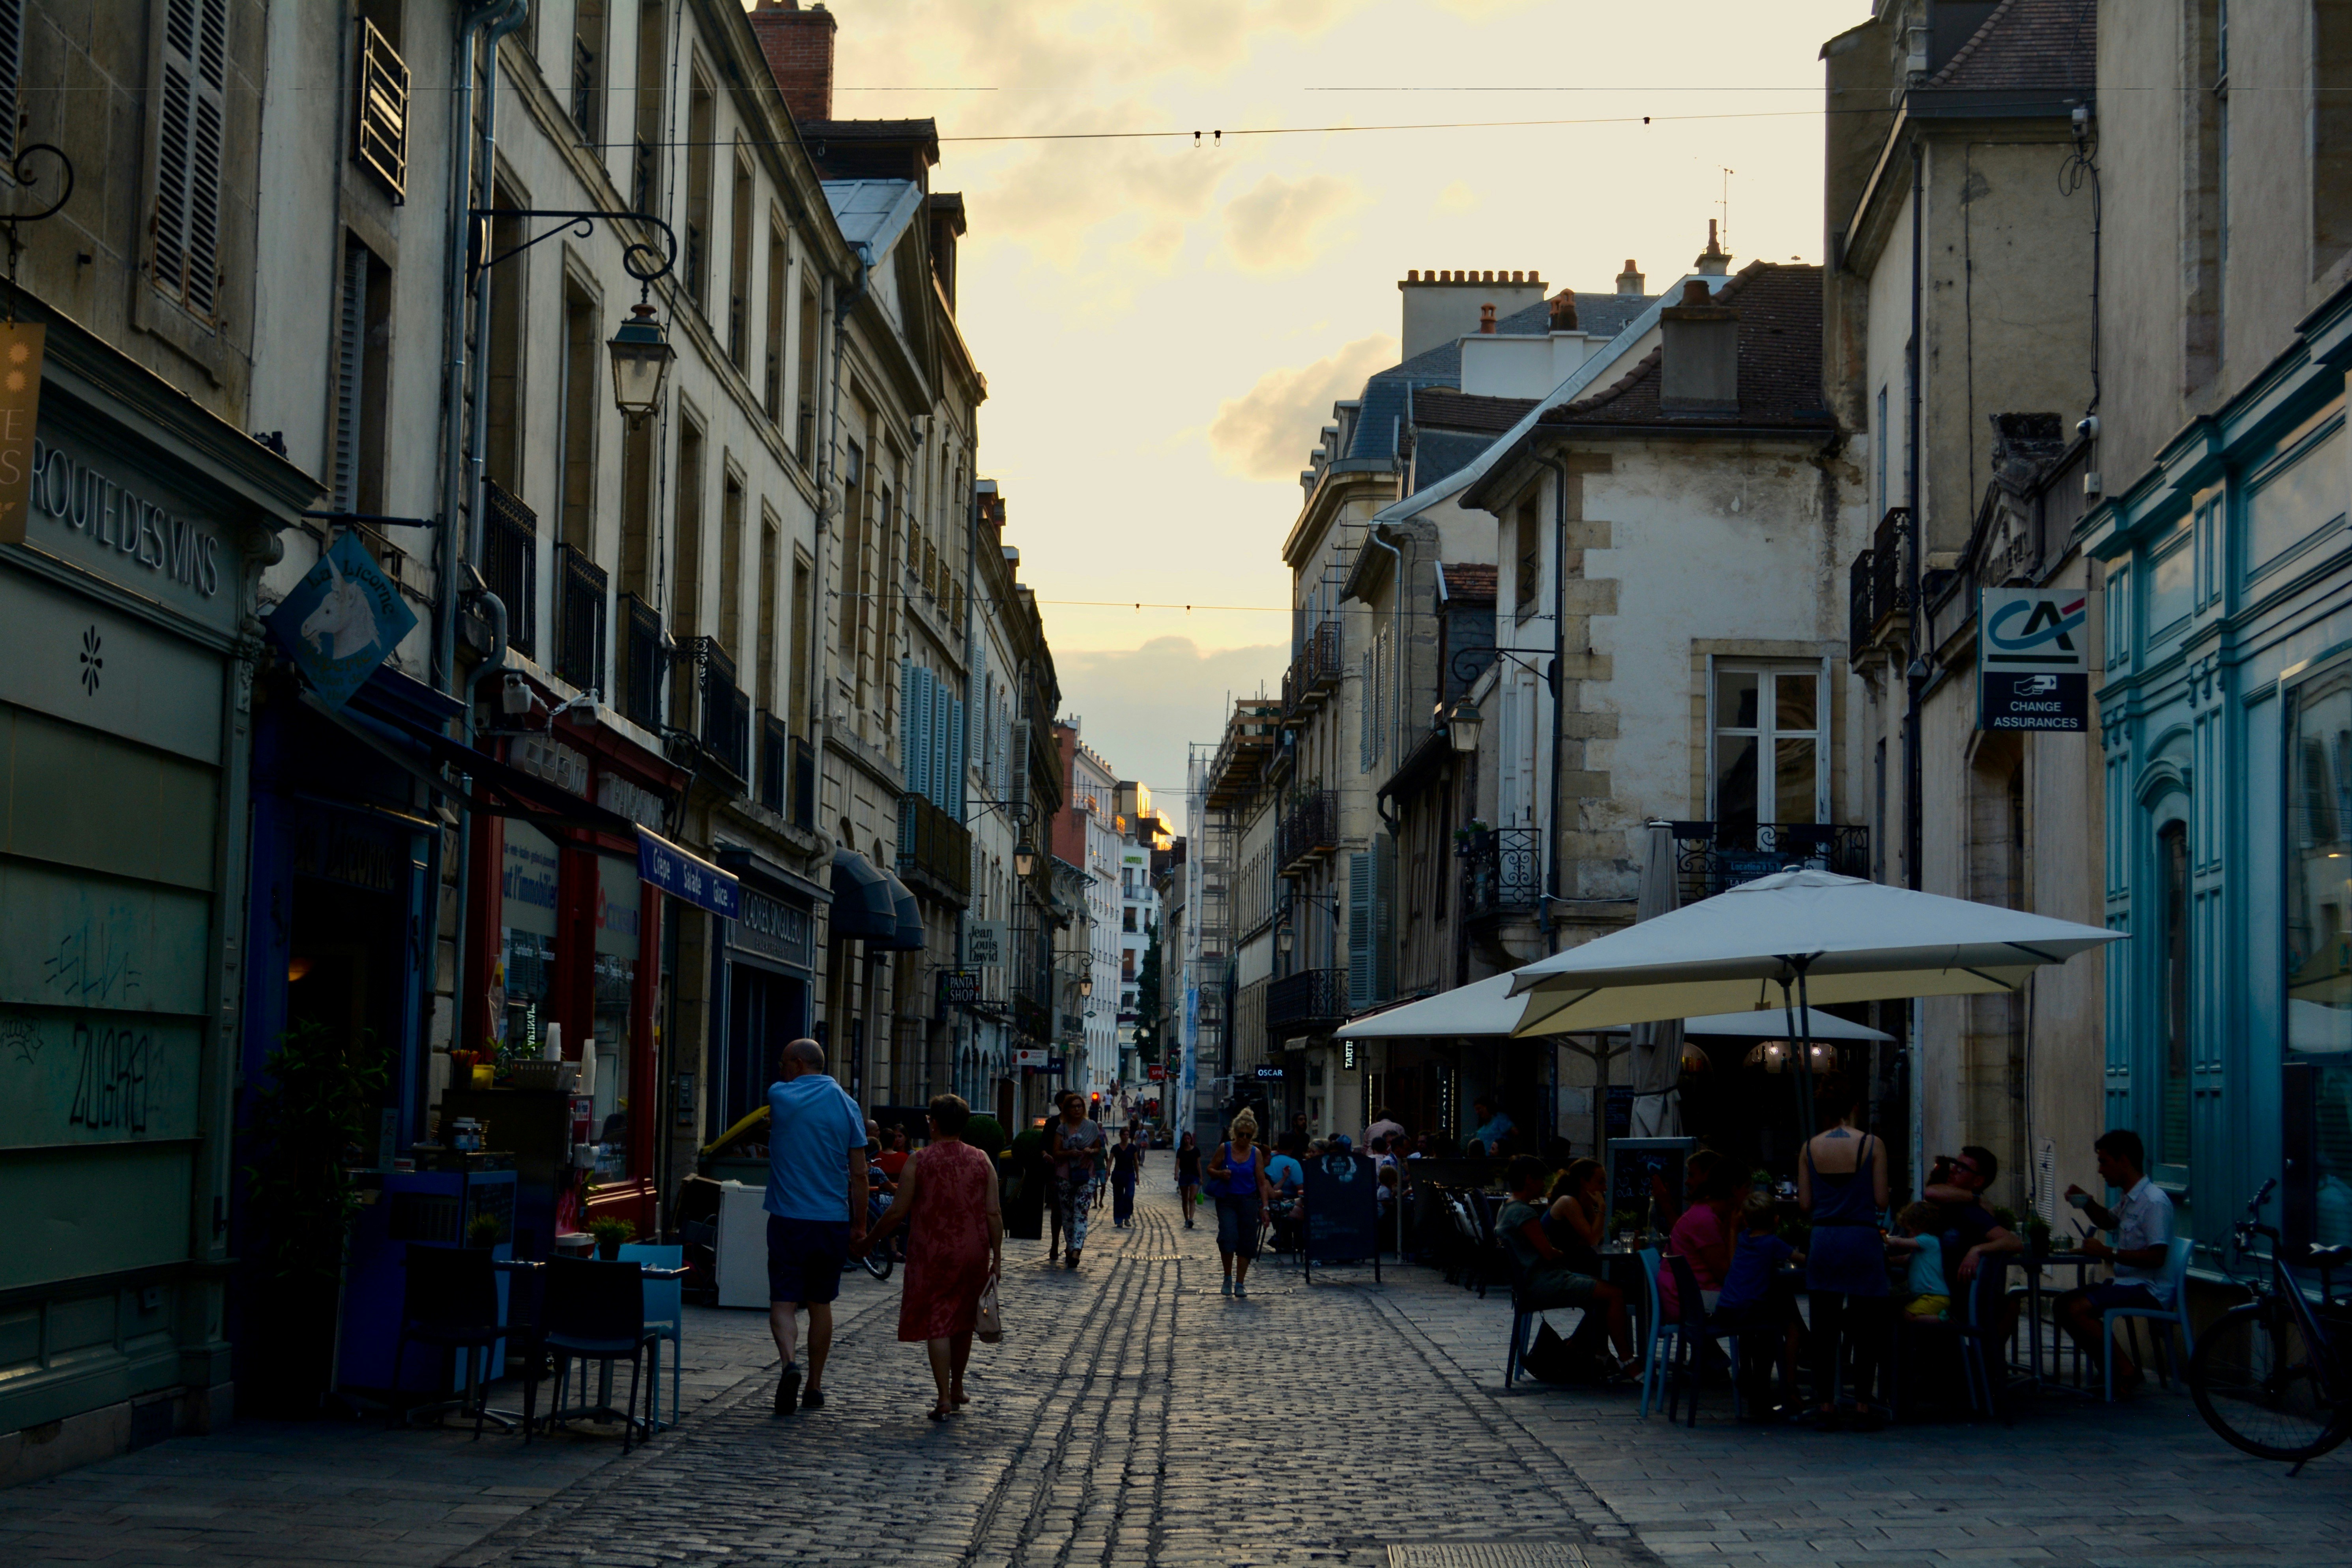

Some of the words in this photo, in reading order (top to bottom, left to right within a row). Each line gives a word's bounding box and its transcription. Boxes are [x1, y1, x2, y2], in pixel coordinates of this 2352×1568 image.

[30, 436, 117, 545] ROUTE
[120, 489, 165, 569] DES
[169, 515, 218, 596] VINS
[306, 567, 333, 589] La
[341, 560, 394, 615] Licorne
[2010, 701, 2061, 712] CHANGE
[1994, 717, 2078, 728] ASSURANCES
[683, 863, 702, 895] Salade
[713, 879, 728, 907] Glace
[968, 926, 992, 938] Jean
[969, 938, 997, 950] Louis
[969, 949, 998, 962] David
[950, 976, 974, 988] PANTA
[950, 989, 974, 1001] SHOP
